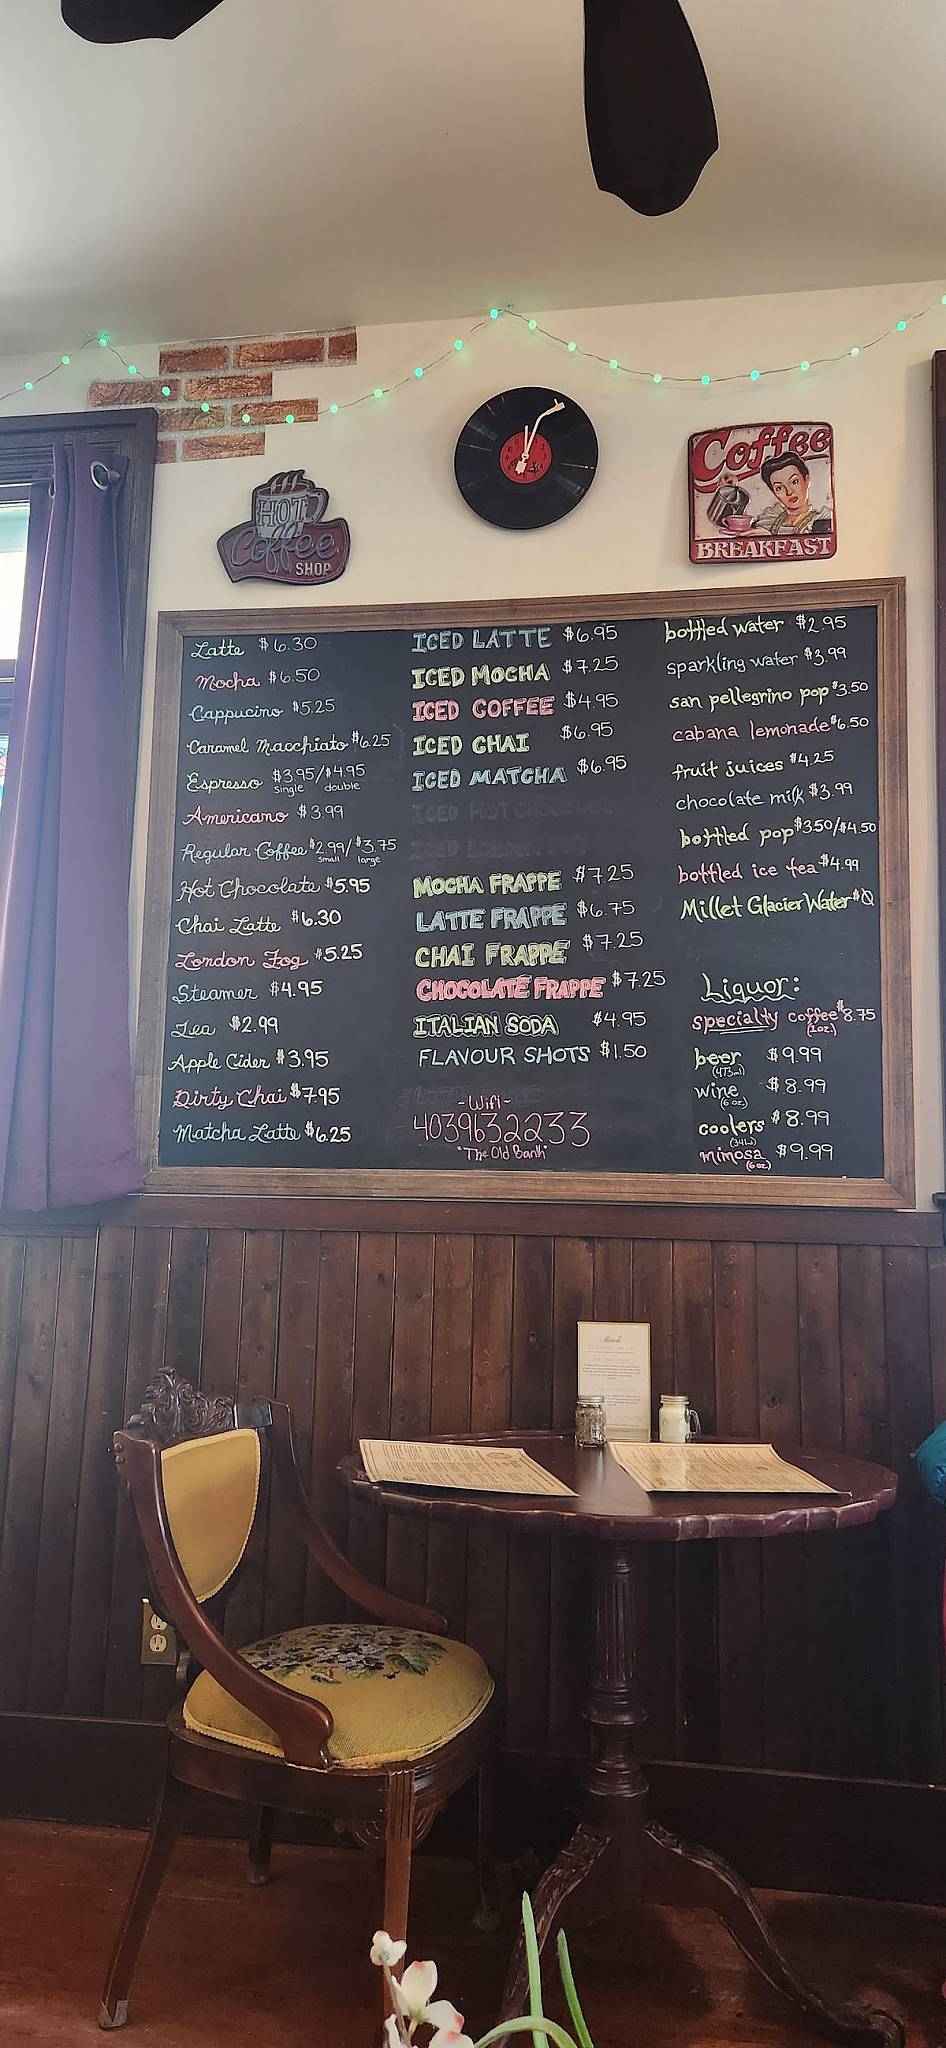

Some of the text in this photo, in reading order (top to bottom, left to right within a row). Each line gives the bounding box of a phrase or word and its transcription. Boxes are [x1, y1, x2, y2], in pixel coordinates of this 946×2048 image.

[691, 425, 832, 482] Coffee
[258, 494, 309, 527] HOT
[231, 522, 337, 574] Coffee
[696, 537, 831, 560] BREAKFAST
[295, 562, 331, 576] SHOP
[411, 625, 618, 653] ICED LATTE $6.95
[664, 613, 847, 643] bottled water $2.95
[191, 639, 244, 659] Latte
[666, 646, 847, 679] sparkling water $3.99
[195, 667, 321, 692] Mocha $6.50
[411, 655, 619, 689] ICED MOCHA $7.25
[412, 691, 619, 722] ICED COFFEE $4.95
[669, 681, 869, 713] san pellegrino pop $3.50
[188, 698, 336, 725] Cappucino $5.25
[412, 721, 614, 756] ICED CHAI $6.95
[672, 714, 870, 742] cabana lemonade $6.50
[186, 730, 392, 756] Caramel Macchiato $6.25
[411, 755, 627, 792] ICED MATCHA $6.95
[672, 750, 835, 781] fruit juices $4.25
[186, 772, 264, 794] Espresso
[273, 783, 304, 797] single
[324, 781, 361, 792] double
[675, 782, 854, 811] chocolate milk $3.99
[182, 803, 344, 827] Americano $3.99
[678, 822, 750, 848] bottled
[759, 826, 794, 847] pop
[181, 843, 251, 864] Regular
[254, 841, 308, 861] Coffee
[317, 855, 341, 863] small
[357, 855, 382, 867] large
[413, 864, 634, 898] MOCHA FRAPPE $7.25
[677, 853, 859, 884] bottled ice tea $4.99
[175, 875, 371, 904] Hot Chocolate $5.95
[416, 907, 486, 933] LATTE
[576, 899, 635, 918] $6.75
[680, 895, 743, 923] Millet
[747, 894, 803, 917] Glacier
[803, 888, 854, 914] Water
[175, 908, 342, 936] Chai Latte $6.30
[174, 943, 363, 971] London Fog $5.25
[414, 942, 475, 968] CHAI
[582, 931, 643, 951] $7.25
[171, 980, 323, 1005] Steamer $4.95
[416, 970, 666, 1002] CHOCOLATE FRAPPE $7.25
[700, 972, 800, 1004] Liquor:
[170, 1015, 280, 1039] Tea $2.99
[413, 1011, 647, 1038] ITALIAN SODA $4.95
[692, 999, 876, 1034] specialty coffee $8.75
[167, 1049, 329, 1074] Apple Cider $3.95
[419, 1040, 647, 1067] FLAVOUR SHOTS $1.50
[694, 1046, 822, 1070] beer $9.99
[172, 1082, 341, 1109] Dirty Chai $7.95
[694, 1082, 739, 1100] wine
[172, 1121, 351, 1144] Matcha Latte $6.25
[413, 1111, 591, 1148] 4039632233
[698, 1113, 765, 1137] coolers
[490, 1146, 510, 1160] Old
[699, 1143, 834, 1165] mimosa $9.99
